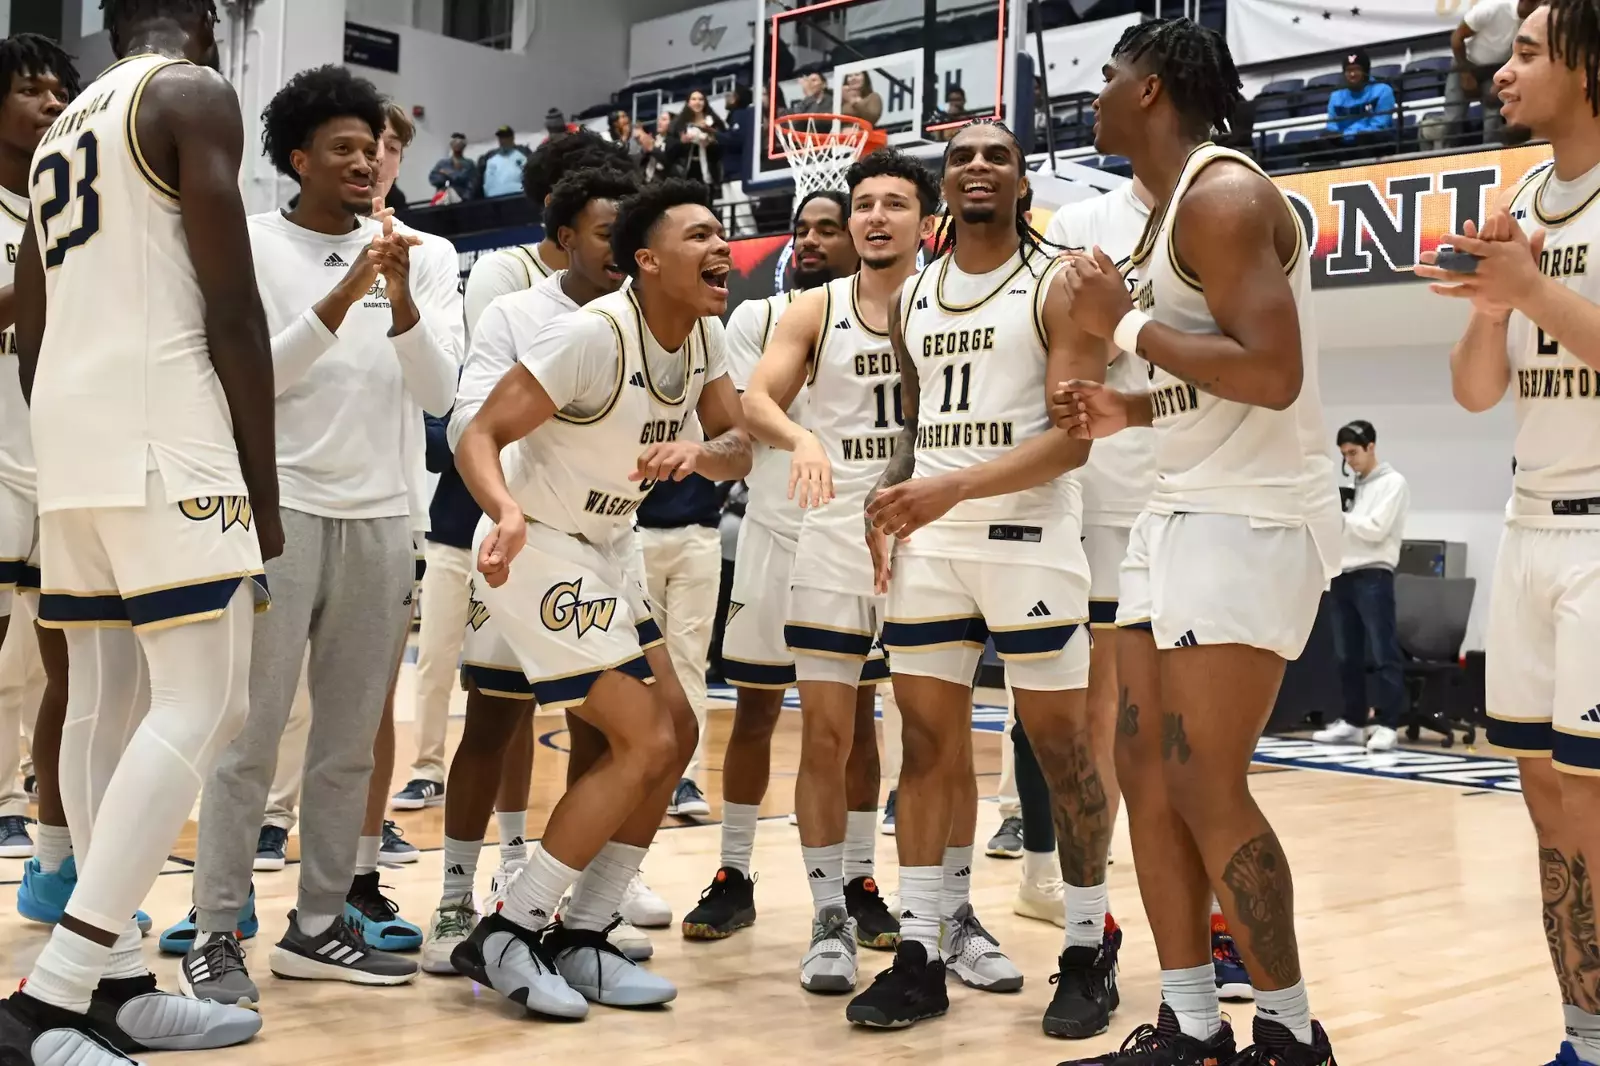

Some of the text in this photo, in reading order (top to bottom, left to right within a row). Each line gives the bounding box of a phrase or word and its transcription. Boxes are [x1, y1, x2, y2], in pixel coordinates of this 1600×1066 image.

[33, 130, 101, 270] 23
[1539, 245, 1588, 277] ORGE
[923, 327, 995, 357] GEORGE
[940, 363, 971, 413] 11
[540, 576, 617, 639] GW
